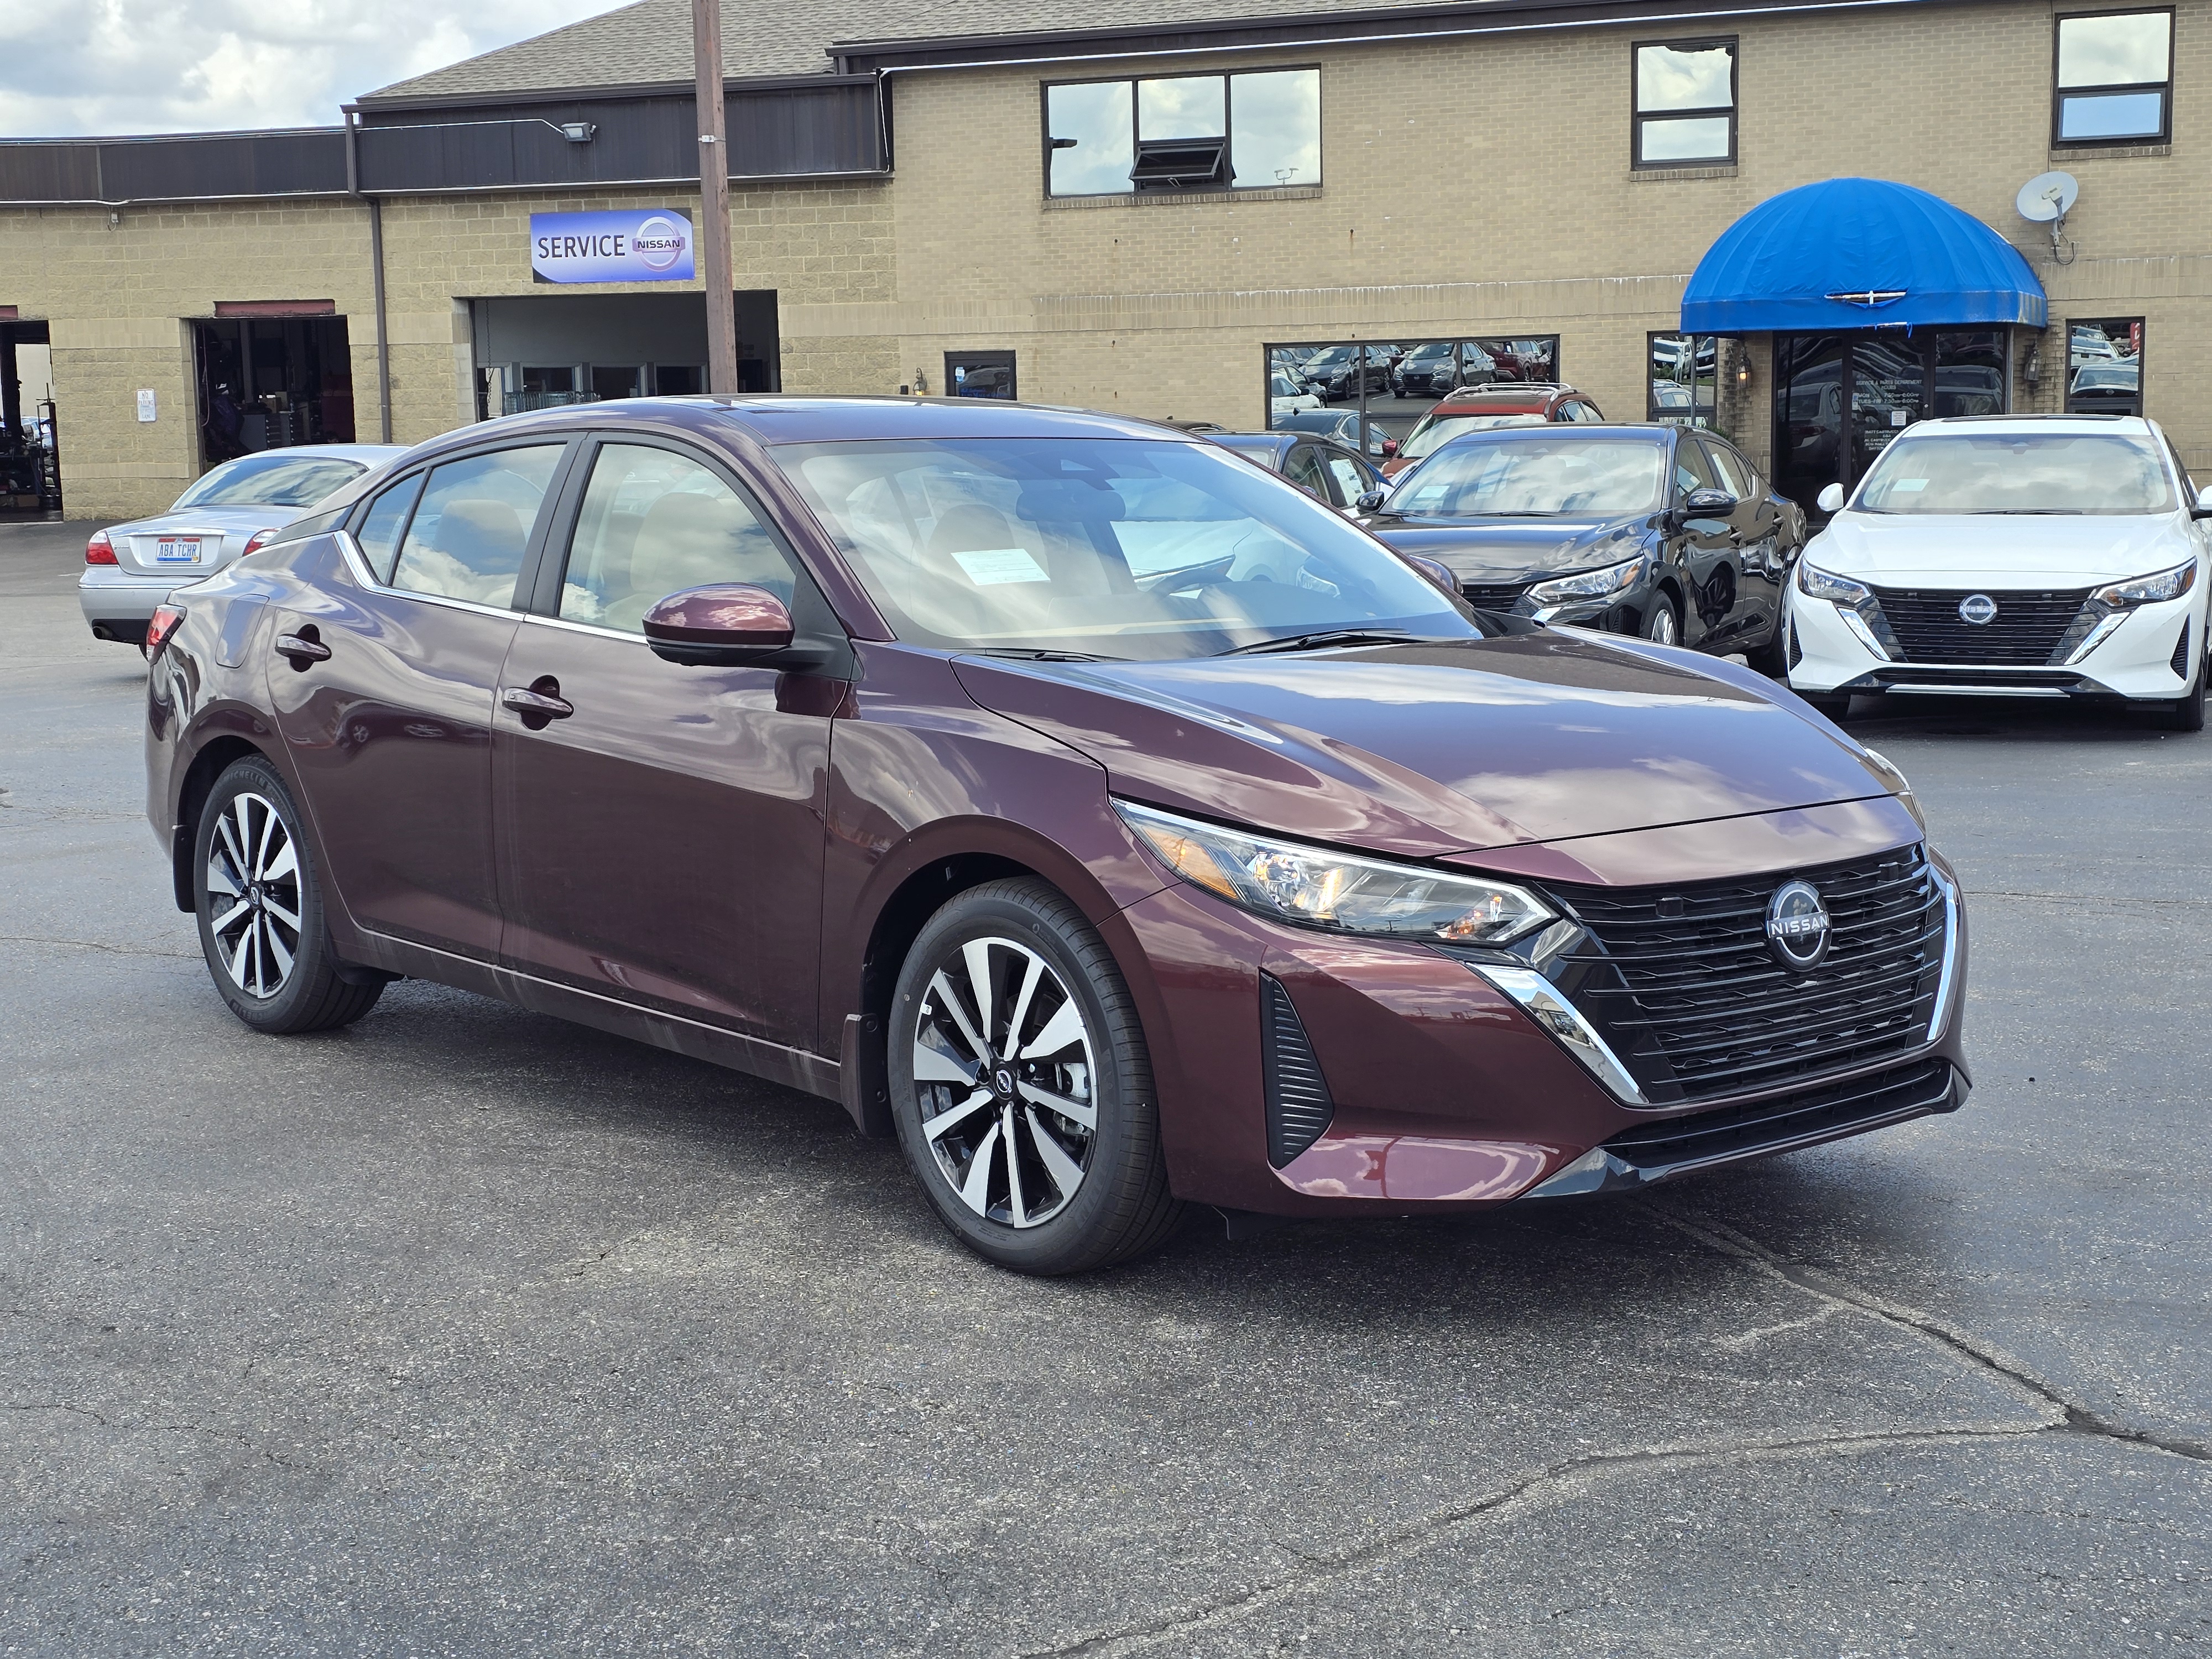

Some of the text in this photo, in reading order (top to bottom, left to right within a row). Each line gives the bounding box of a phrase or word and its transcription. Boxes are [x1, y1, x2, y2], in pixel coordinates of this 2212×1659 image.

[538, 234, 680, 259] SERVICE NISSAN
[159, 544, 197, 557] ABA TCHR
[1771, 914, 1829, 935] NISSAN
